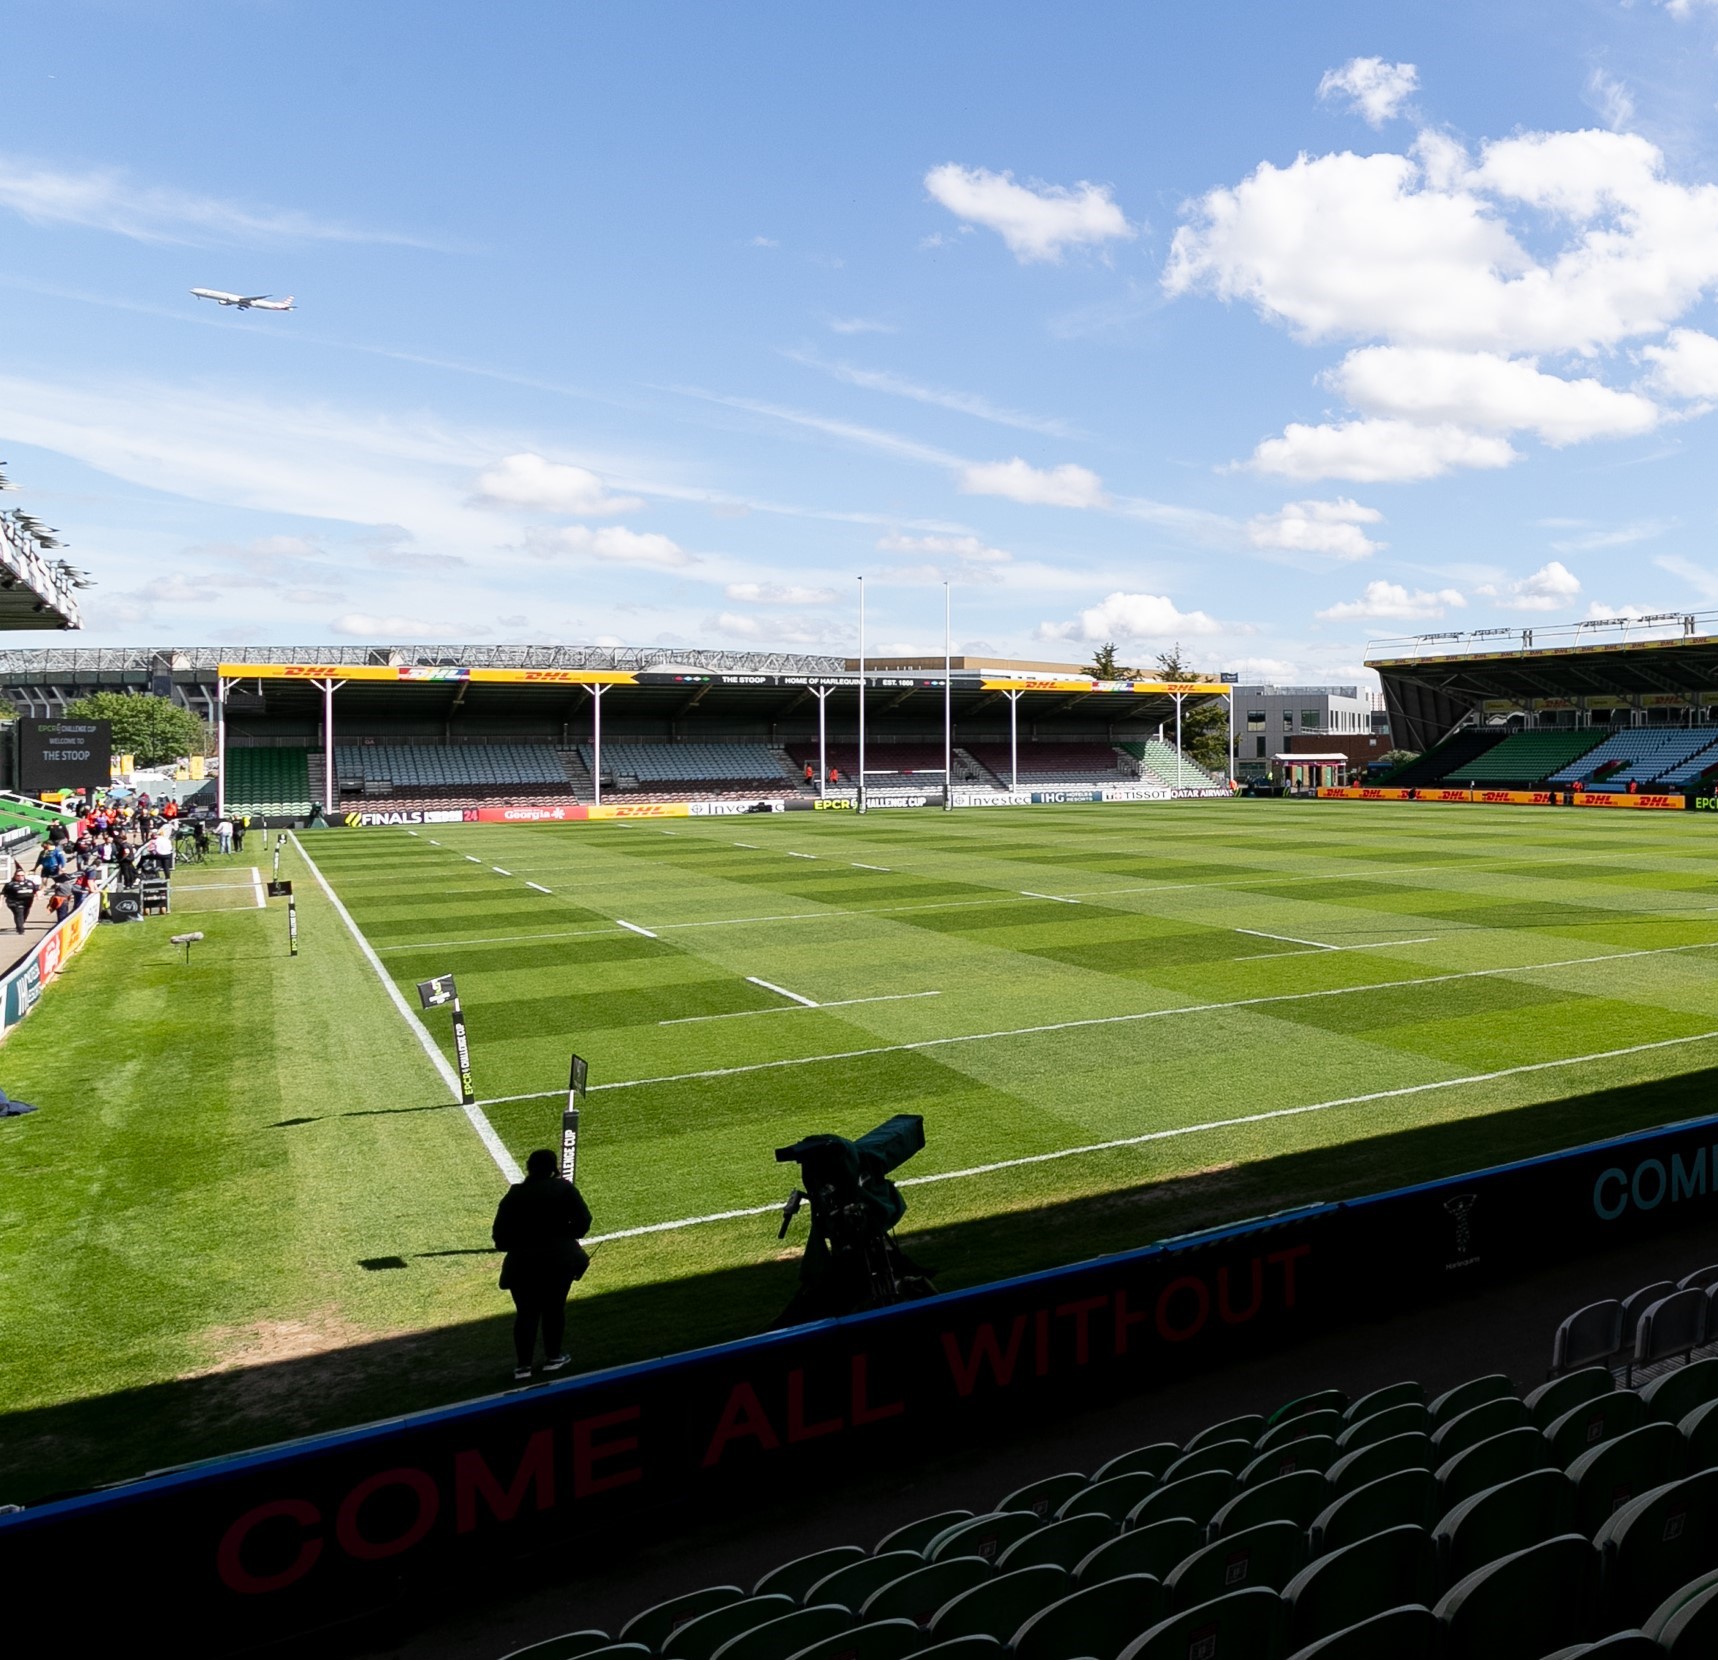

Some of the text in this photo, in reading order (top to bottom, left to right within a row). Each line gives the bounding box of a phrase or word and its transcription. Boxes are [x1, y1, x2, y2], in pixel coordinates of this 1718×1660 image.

[284, 667, 340, 676] DHL
[409, 669, 466, 679] DHL
[525, 672, 572, 681] DHL
[43, 751, 91, 761] THE STOOP
[1041, 793, 1065, 803] IHG
[1124, 791, 1167, 799] TISSOT
[1172, 790, 1199, 798] QATAR
[1327, 789, 1345, 797] DHL
[1362, 790, 1382, 798] DHL
[1442, 791, 1463, 800] DHL
[1487, 792, 1511, 802] DHL
[814, 797, 927, 810] EPCR HALLENGE CUP
[969, 796, 1031, 806] Investec
[1585, 795, 1613, 805] DHL
[1640, 797, 1670, 807] DHL
[616, 806, 665, 817] DHL
[709, 803, 784, 814] Invec
[362, 812, 424, 826] FINALS
[464, 811, 478, 822] 24
[505, 809, 550, 821] Georgia
[456, 1023, 474, 1096] EPCR CHALLENGE CUP
[562, 1129, 576, 1184] ALLENGE CUP
[214, 1404, 647, 1596] COME
[699, 1352, 908, 1472] ALL
